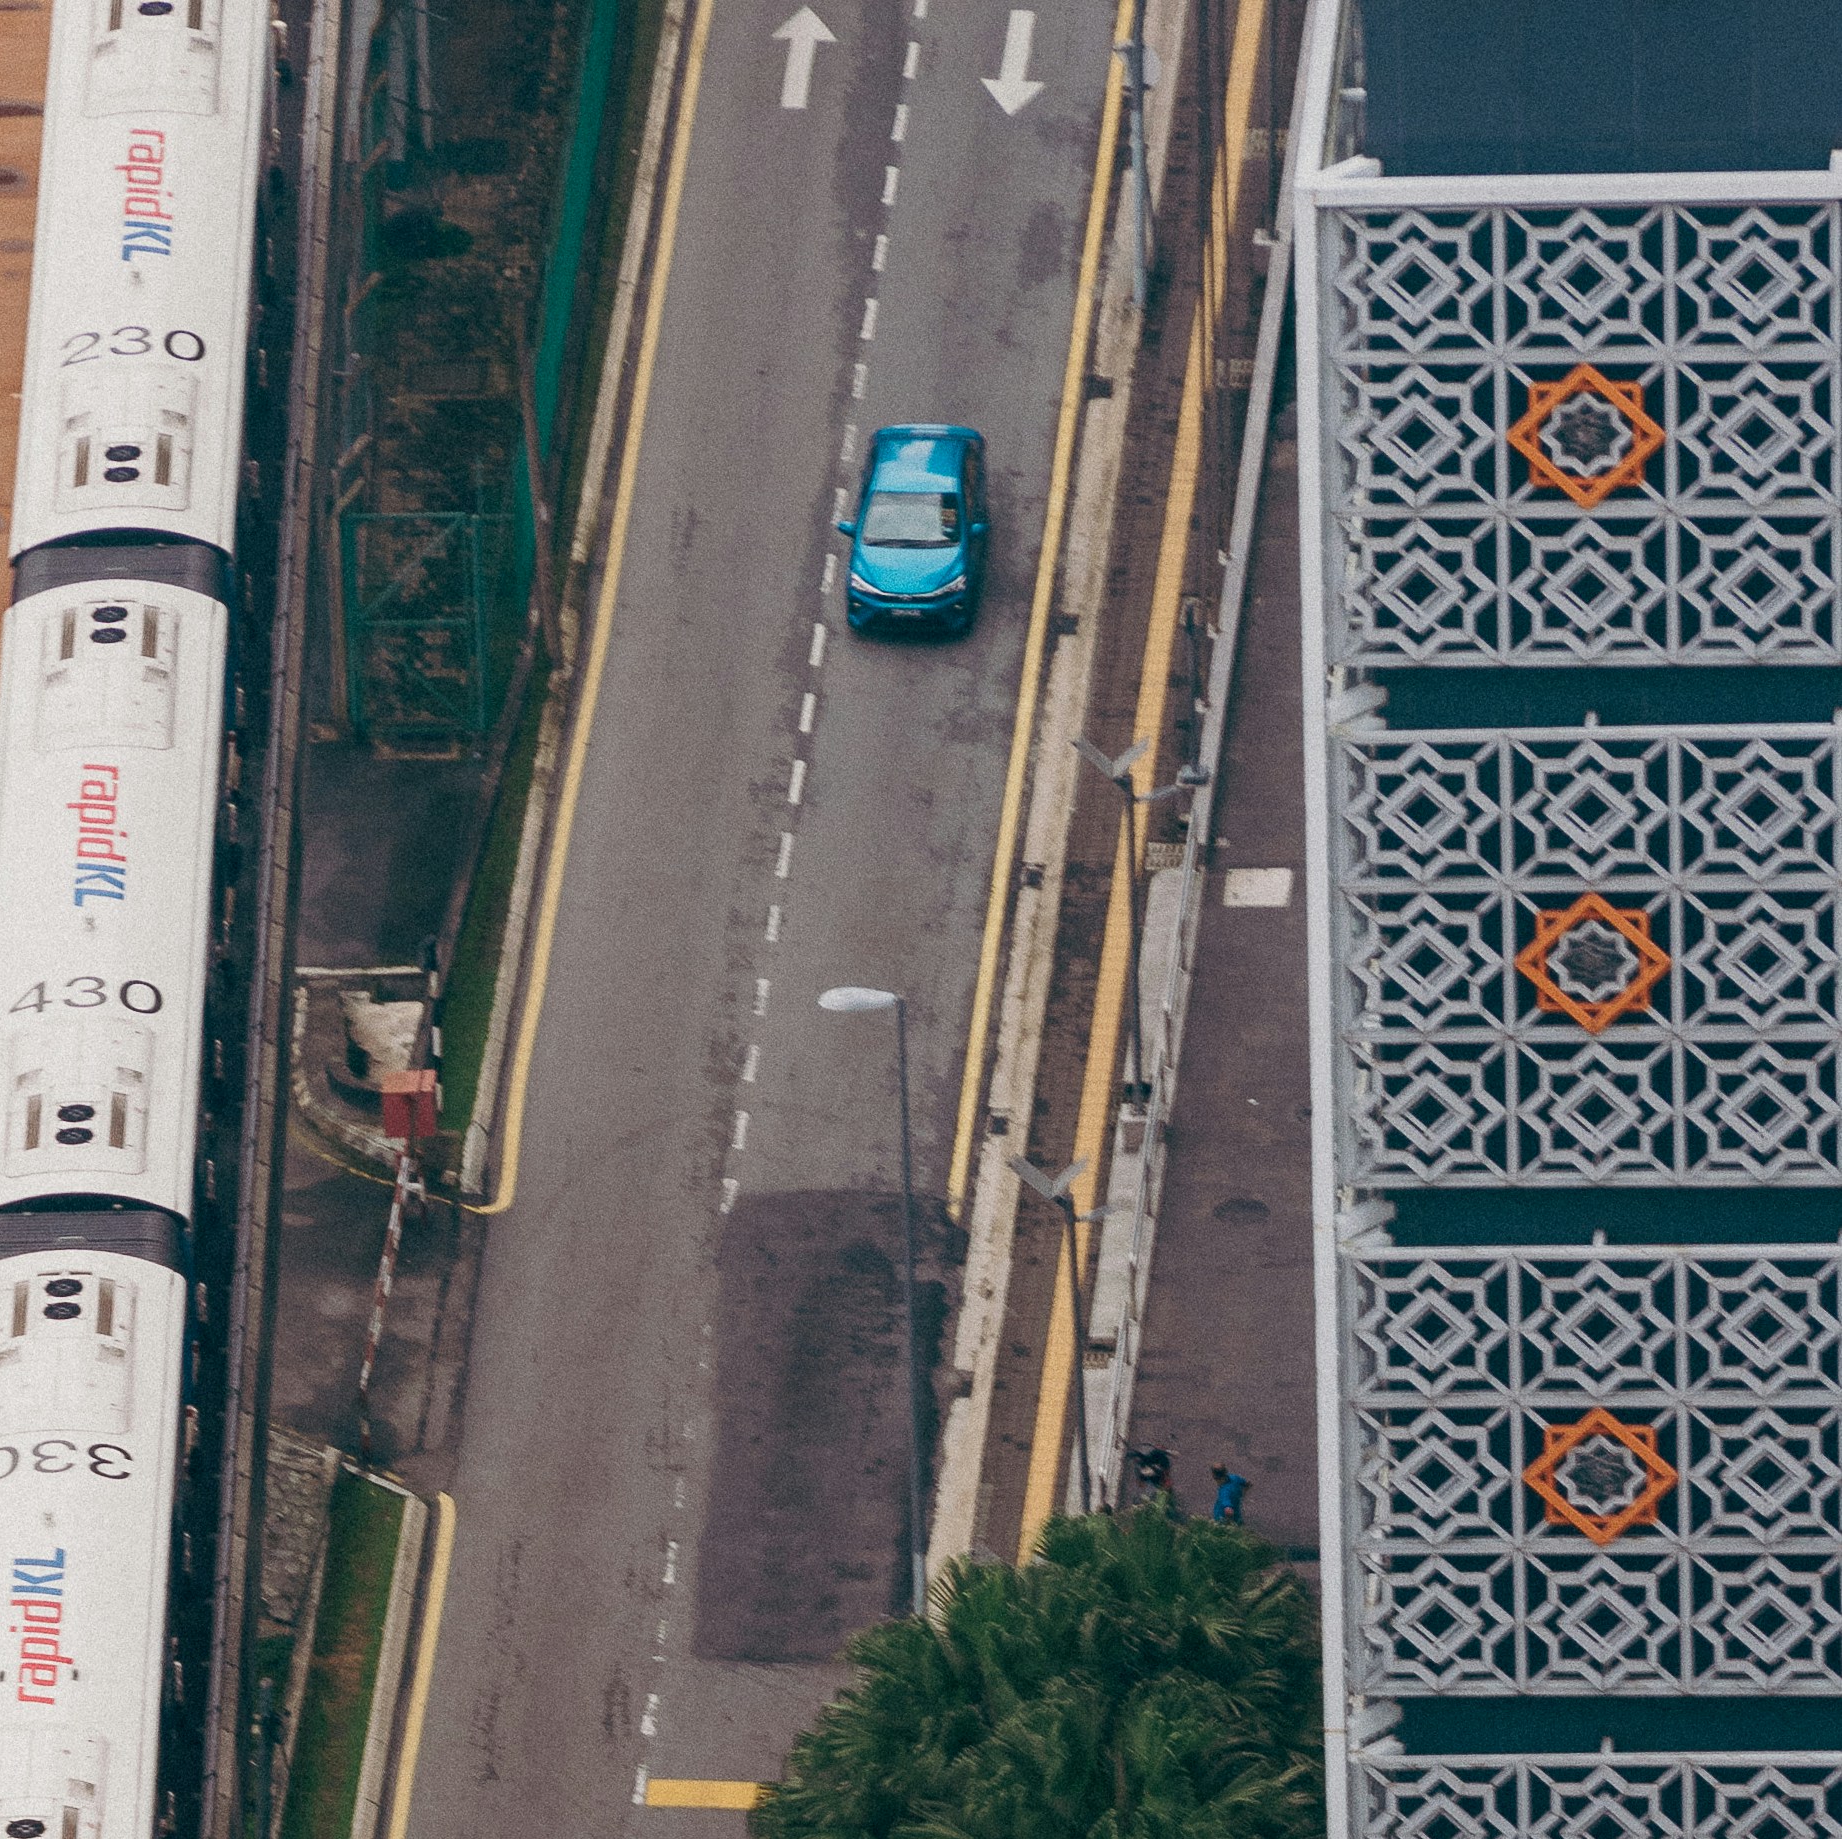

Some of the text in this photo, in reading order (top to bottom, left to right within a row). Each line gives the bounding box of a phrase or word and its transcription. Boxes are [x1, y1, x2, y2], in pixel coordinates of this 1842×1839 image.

[114, 128, 173, 262] rapidKL
[61, 326, 206, 367] 230
[67, 763, 129, 907] rapidKL
[9, 976, 163, 1014] 430
[9, 1547, 74, 1706] rapidKL
